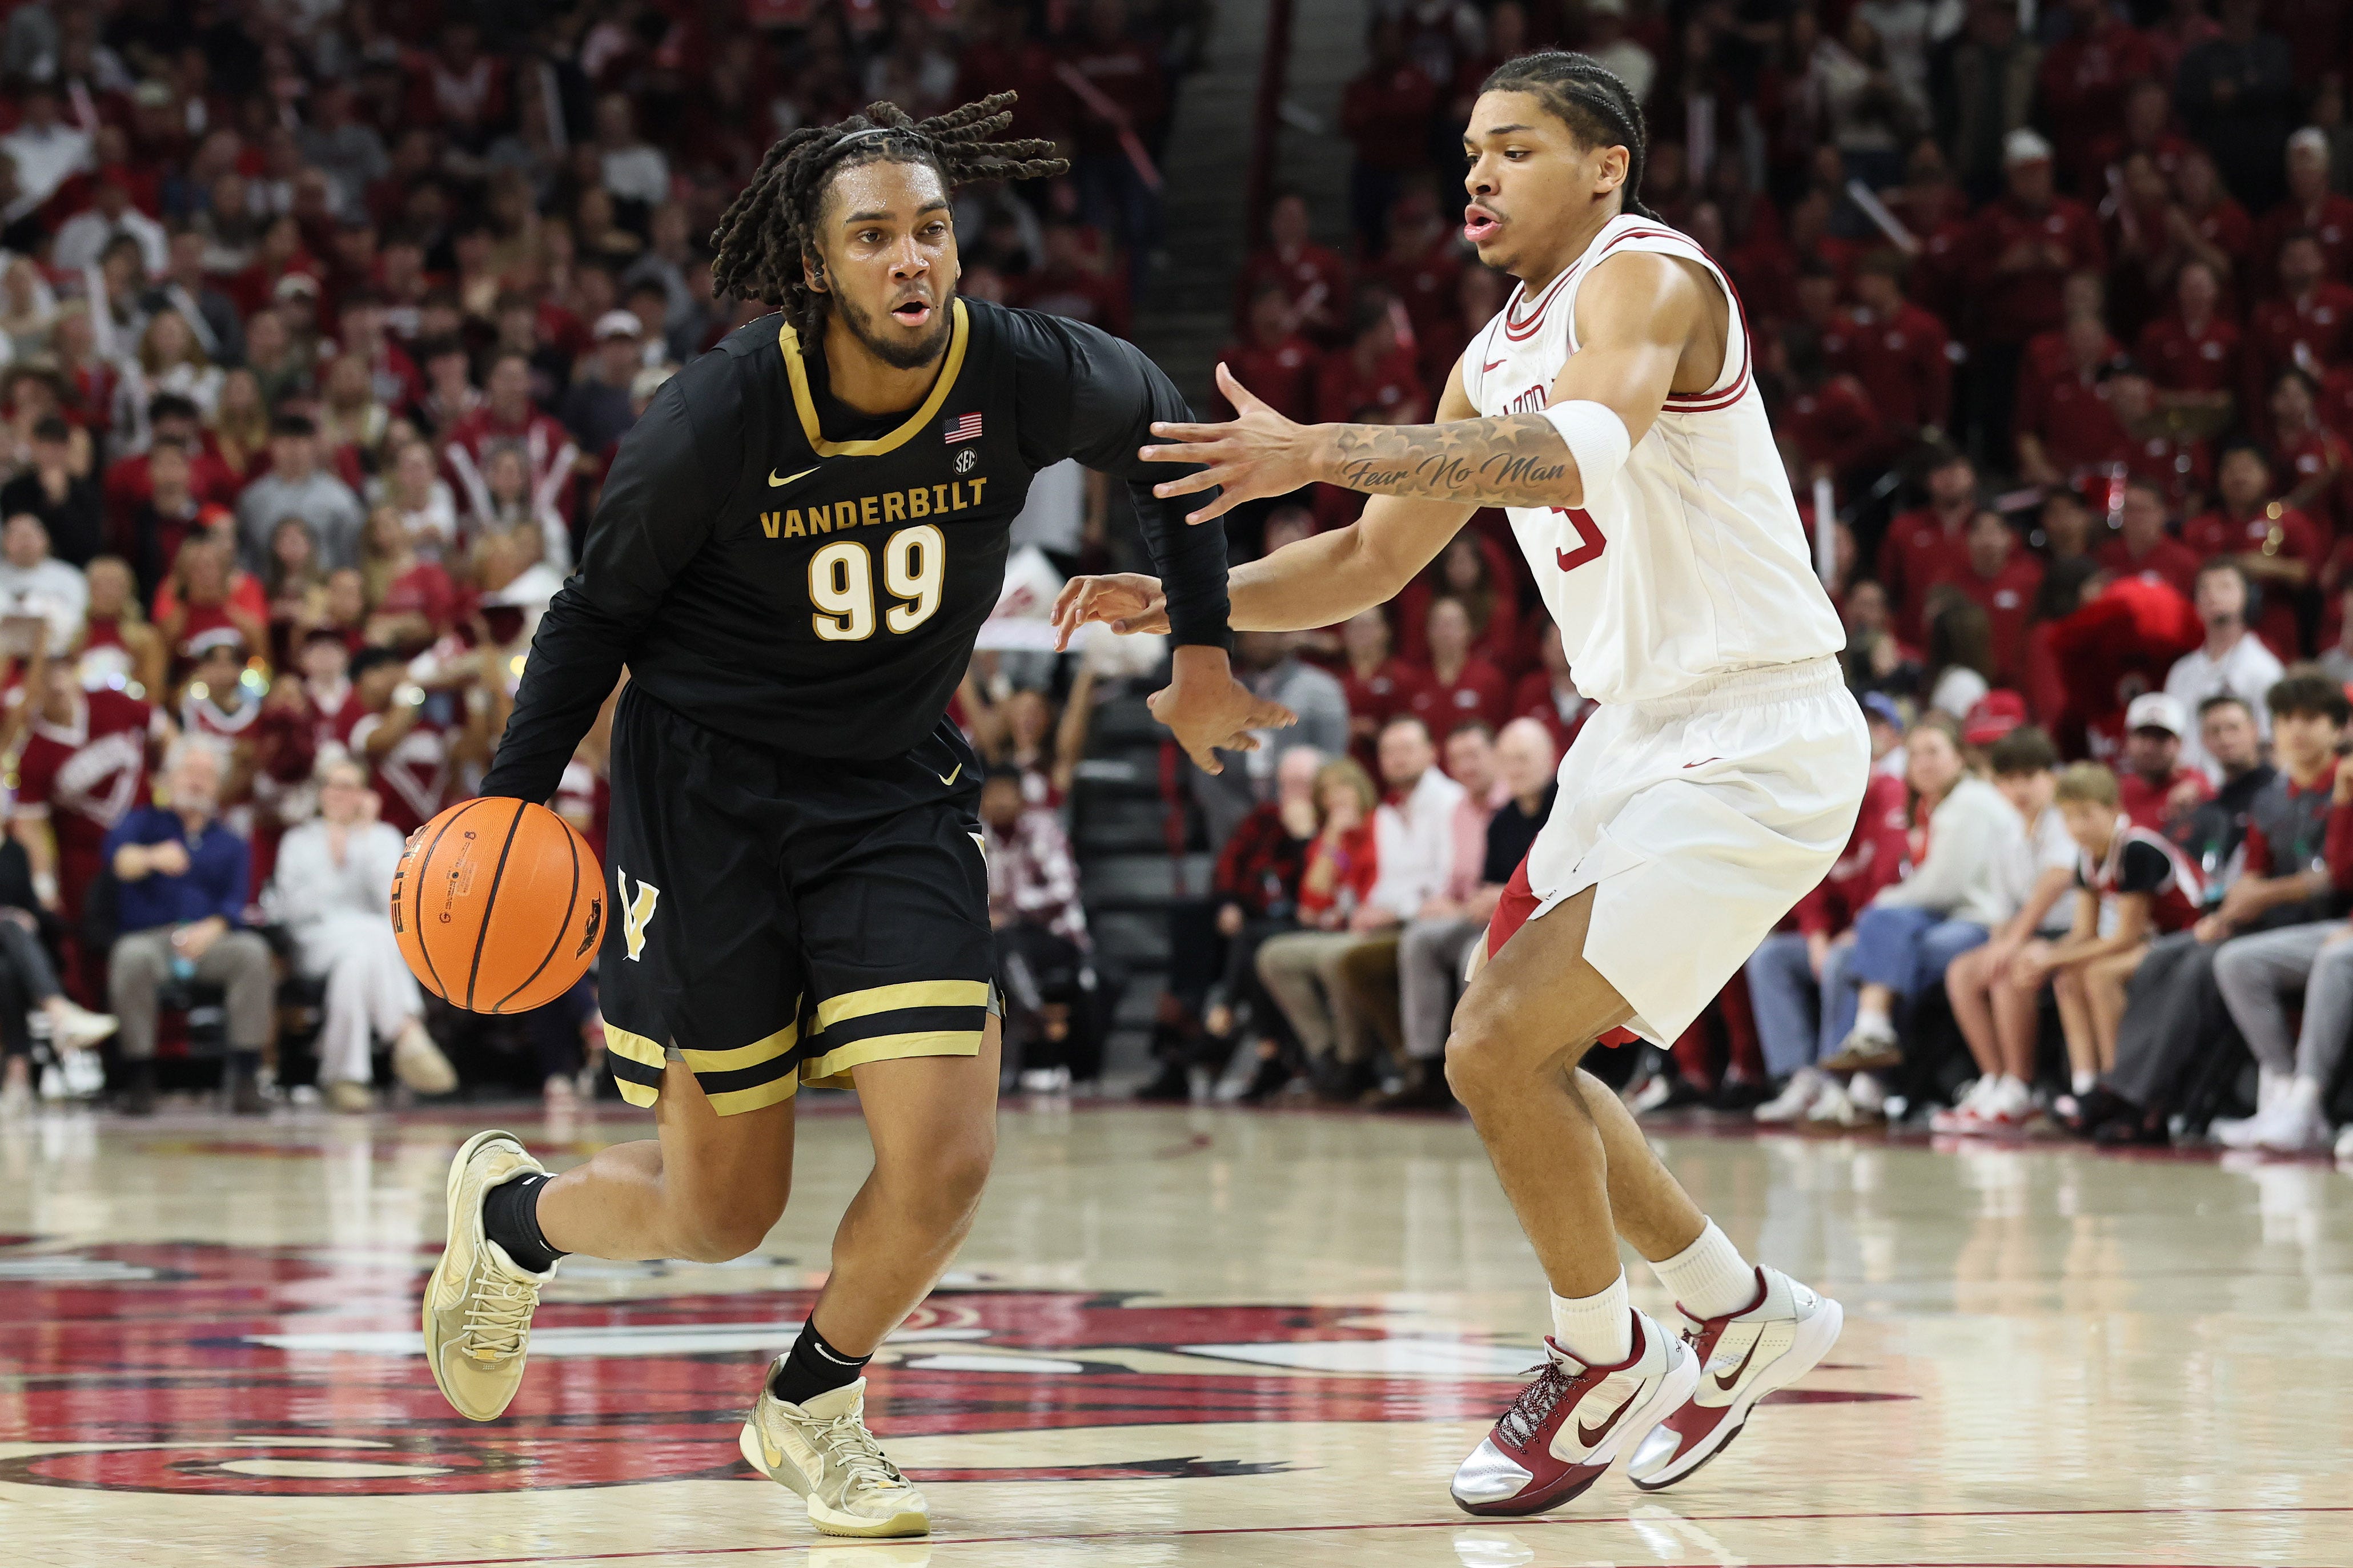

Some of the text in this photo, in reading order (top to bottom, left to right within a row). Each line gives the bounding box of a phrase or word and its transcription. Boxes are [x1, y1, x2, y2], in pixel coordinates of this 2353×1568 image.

[955, 449, 975, 473] SEC
[1342, 452, 1566, 489] Fear No Man
[760, 477, 987, 538] VANDERBILT
[808, 524, 946, 641] 99
